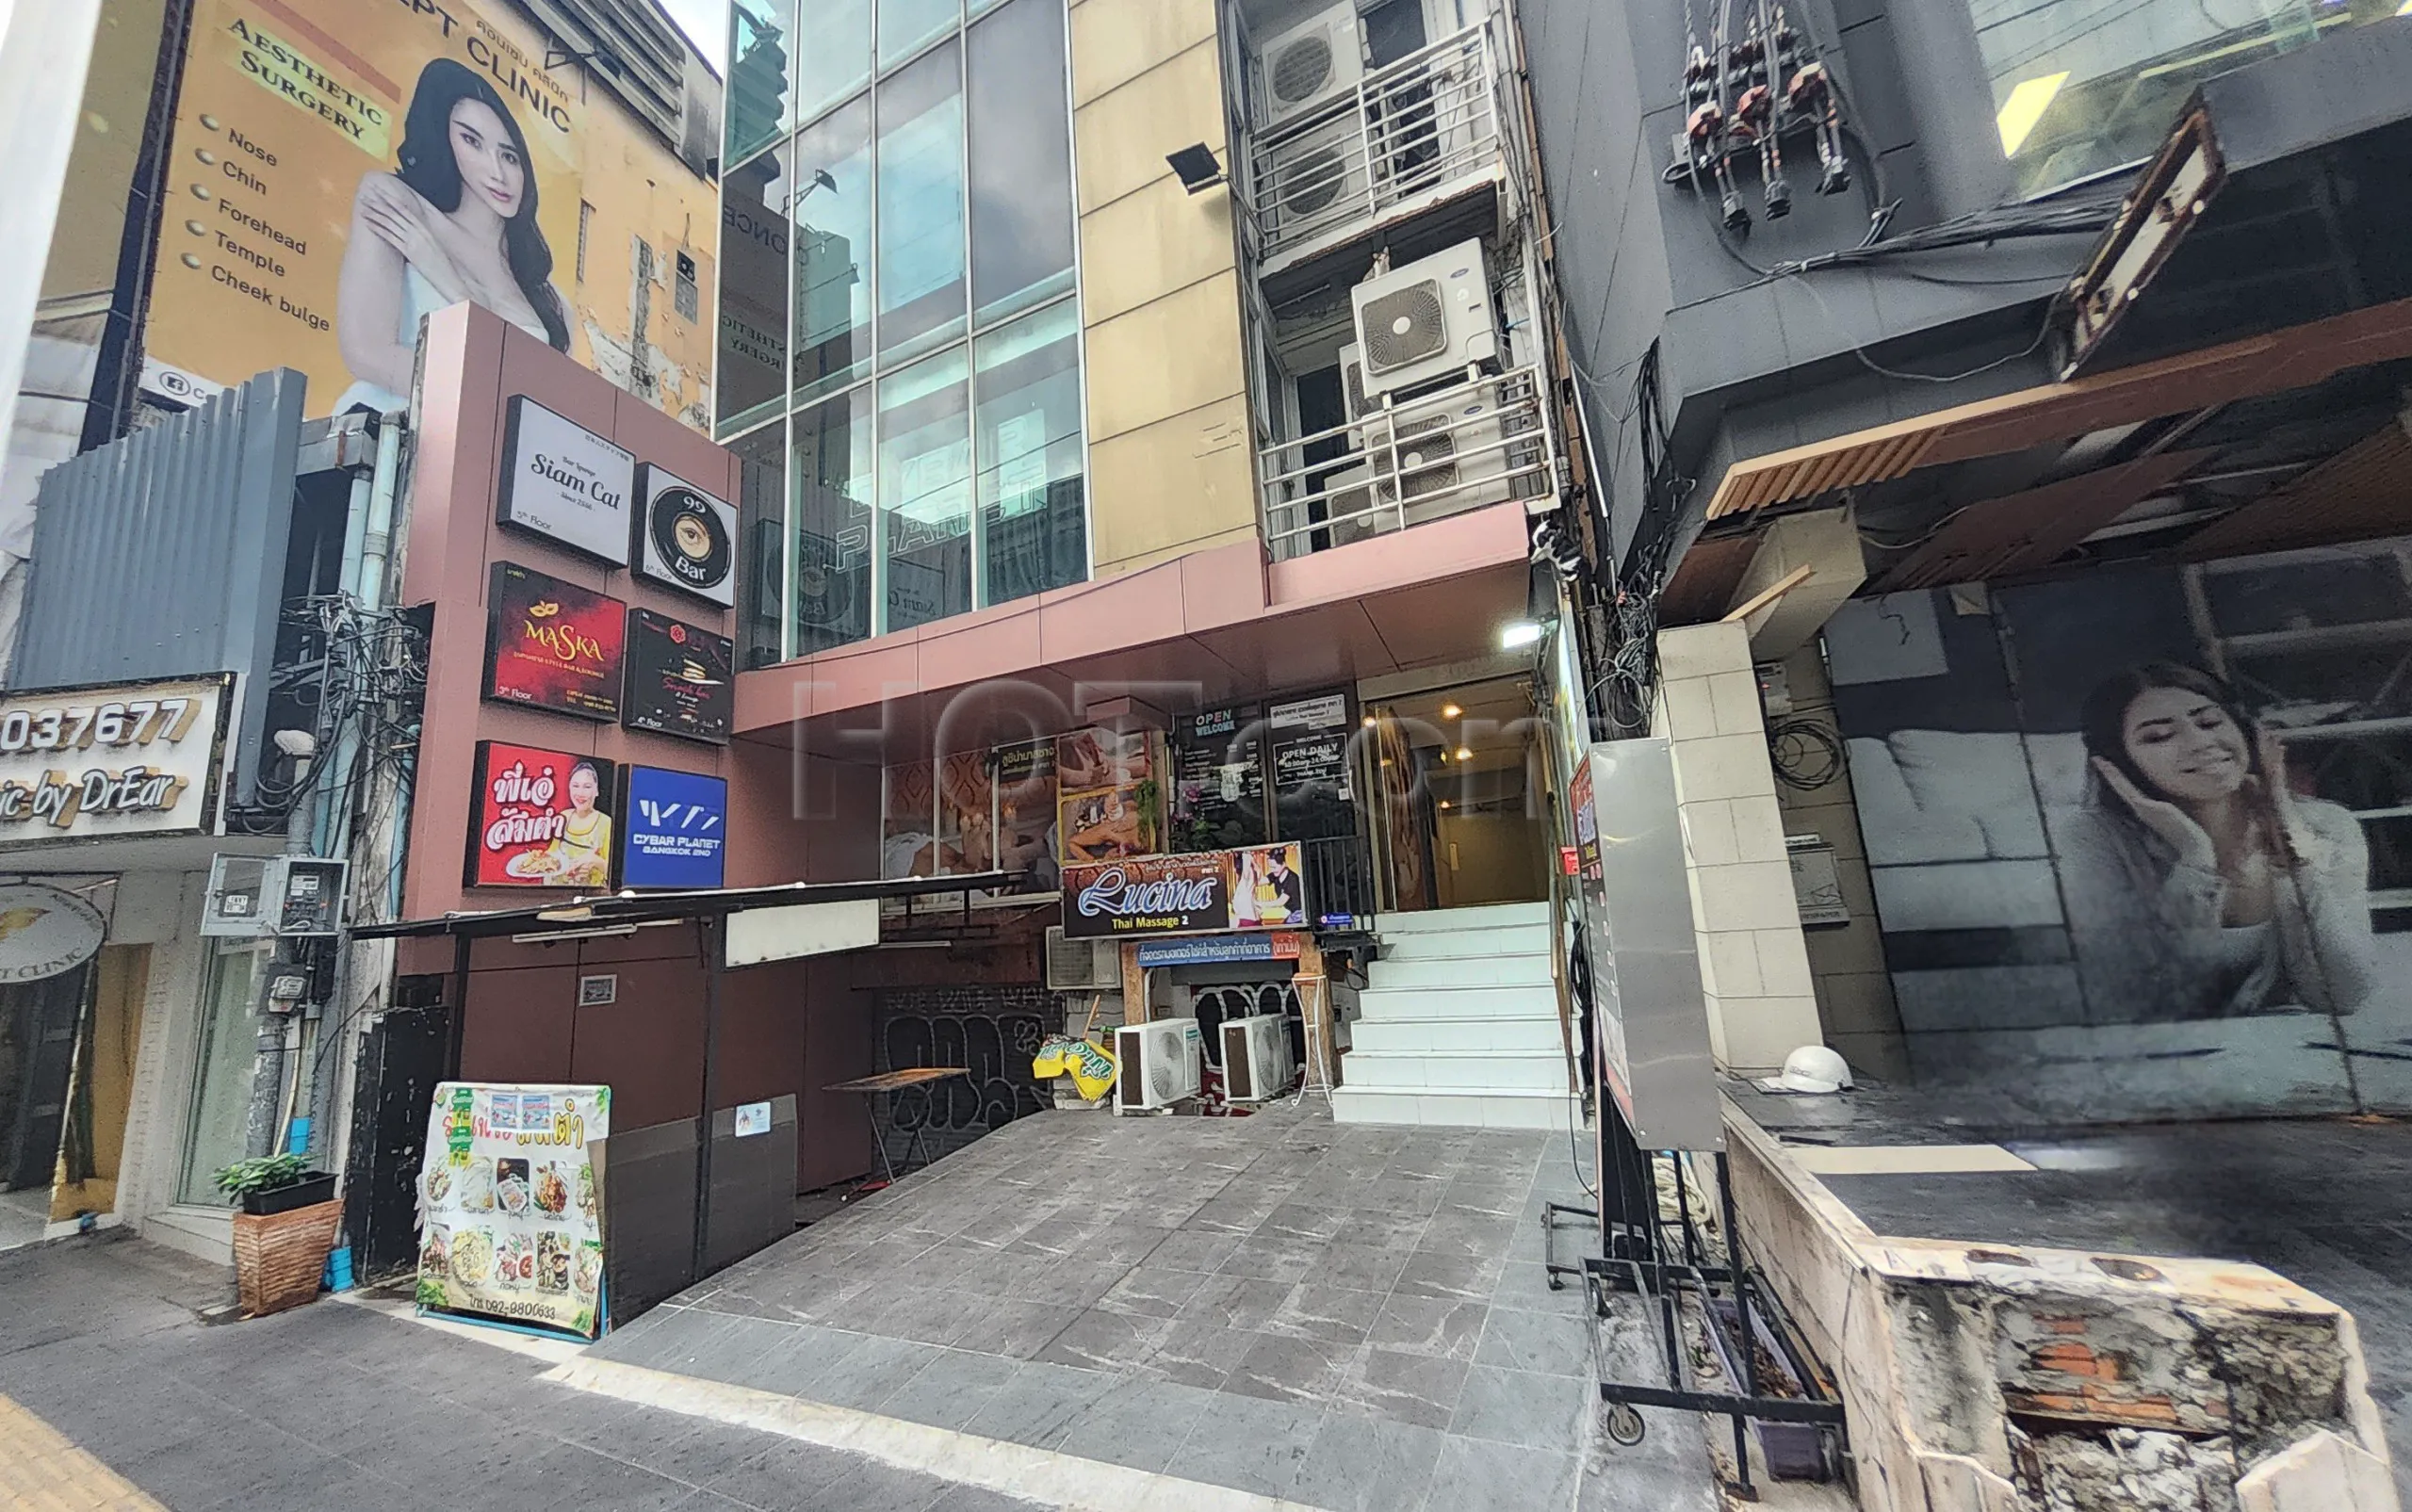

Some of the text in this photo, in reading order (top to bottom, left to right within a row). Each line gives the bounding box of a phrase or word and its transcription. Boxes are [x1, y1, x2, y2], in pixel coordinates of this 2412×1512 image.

[228, 18, 383, 125] AESTHETIC
[467, 36, 569, 133] CLINIC
[240, 50, 365, 139] SURGERY
[228, 127, 278, 167] Nose
[222, 160, 267, 195] Chin
[218, 198, 307, 255] Forehead
[215, 230, 285, 277] Temple
[212, 265, 330, 332] Cheek bulge
[530, 453, 621, 510] Siam Cat
[530, 514, 552, 530] Floor
[683, 496, 706, 513] 99
[675, 556, 707, 580] Bar
[524, 619, 605, 661] MASKA
[511, 688, 532, 700] Floor
[1, 698, 189, 751] 037677
[646, 718, 662, 727] Floor
[1195, 708, 1231, 725] OPEN
[1195, 720, 1235, 737] WELCOME
[1282, 741, 1338, 758] OPEN DAILY
[34, 770, 73, 824] by
[80, 766, 176, 812] DrEar
[486, 807, 565, 851] ส้มตำ
[633, 834, 721, 849] CYBAR PLANET
[643, 846, 691, 855] BANGKOK
[1078, 867, 1218, 917] Lucina
[1112, 916, 1189, 930] Thai Massage 2
[18, 947, 83, 977] CLINIC
